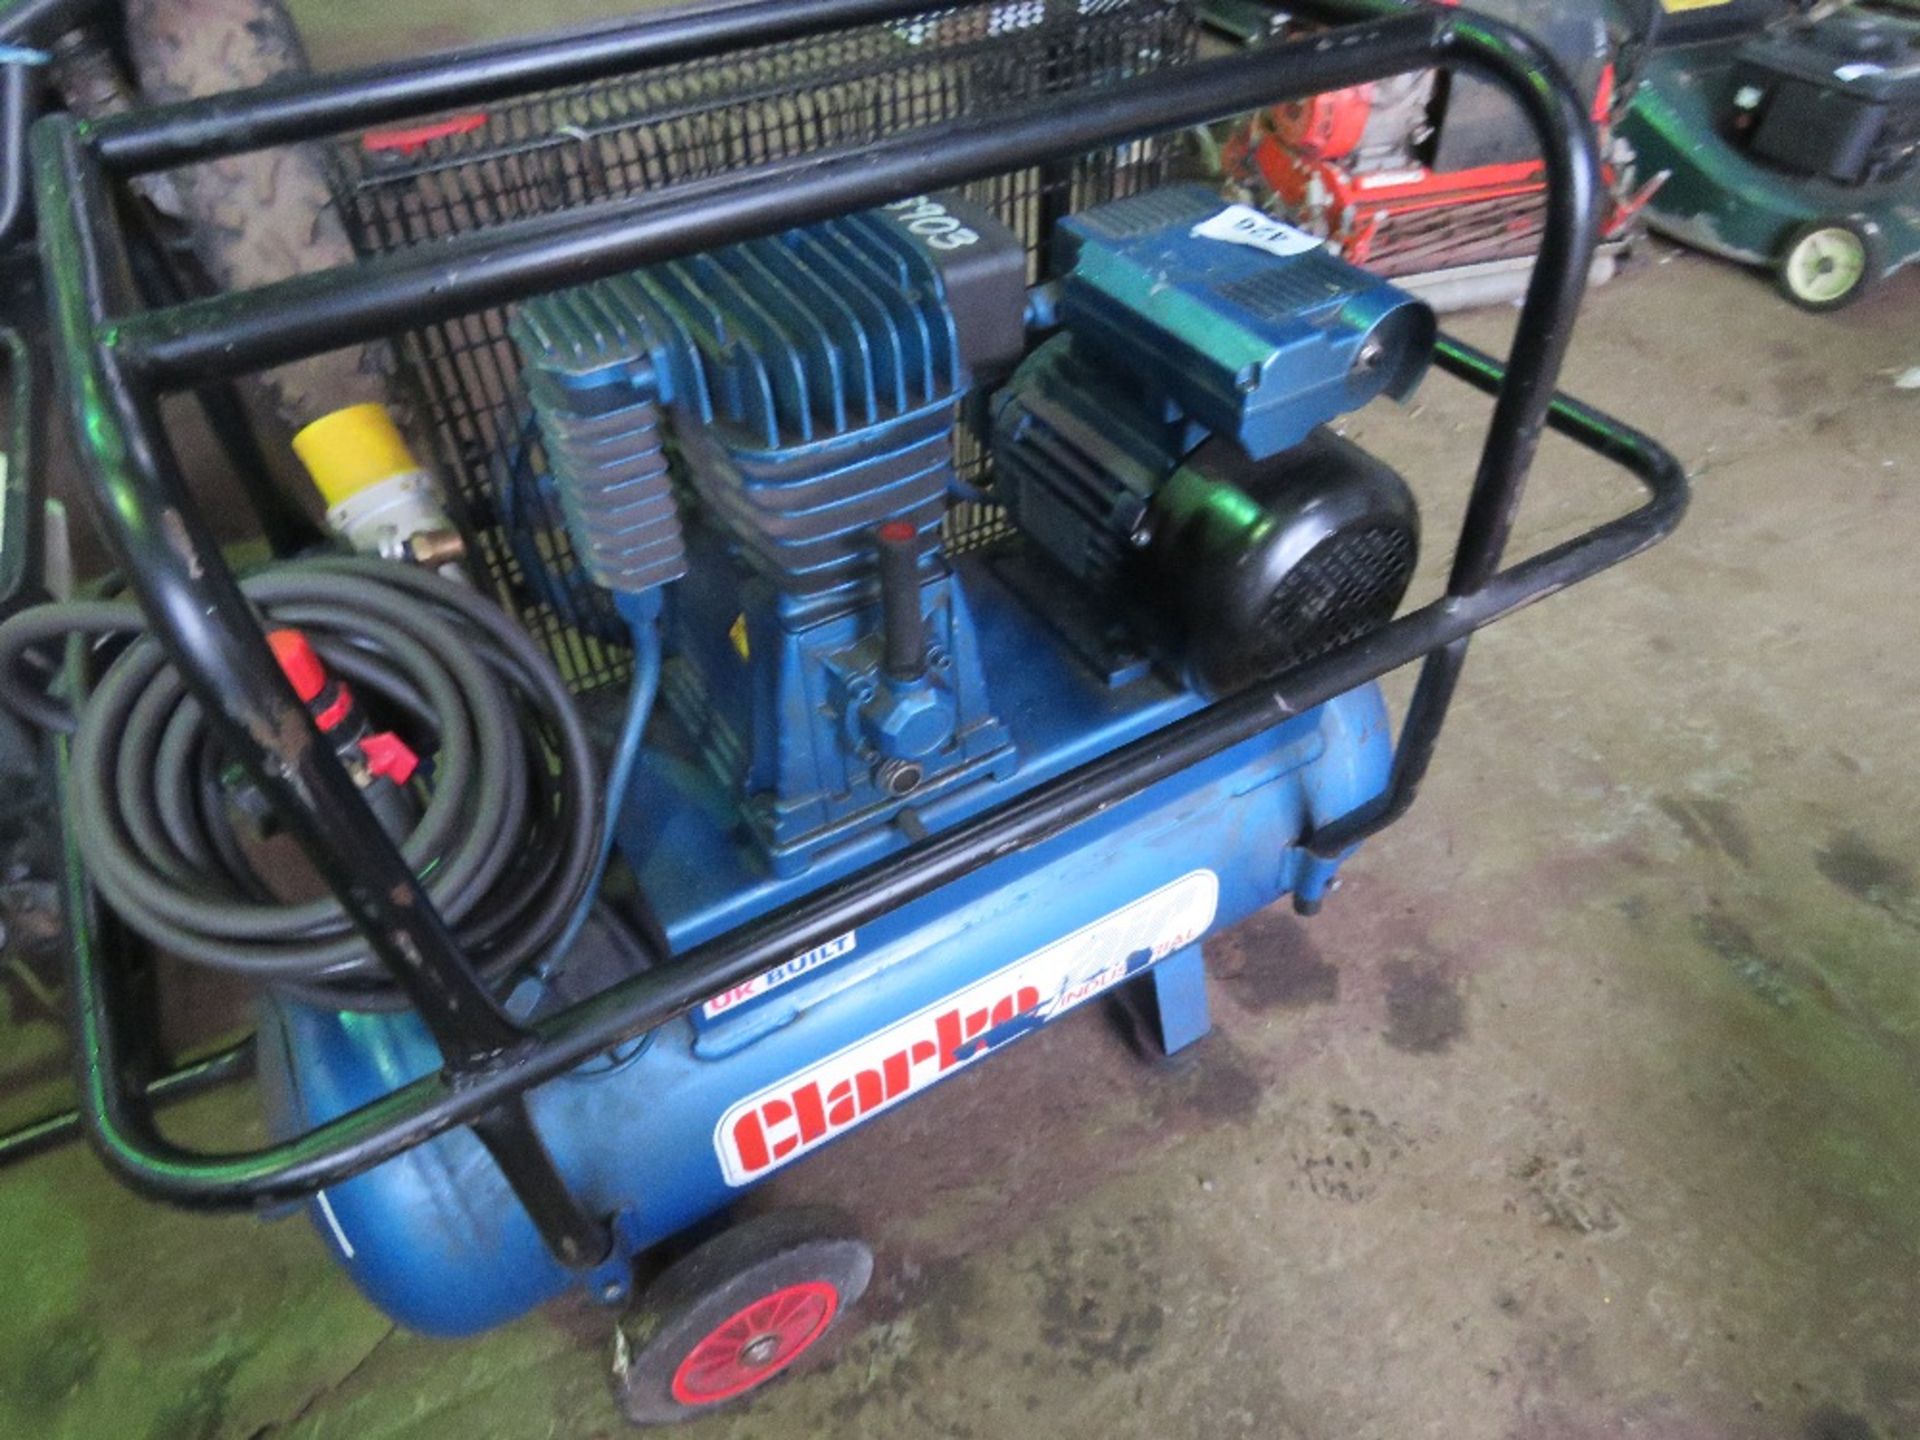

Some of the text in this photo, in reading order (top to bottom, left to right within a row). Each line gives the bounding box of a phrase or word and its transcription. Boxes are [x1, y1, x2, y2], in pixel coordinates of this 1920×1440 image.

[709, 937, 850, 1012] UK BUILT
[1060, 928, 1194, 1009] INDUSRIAL
[733, 986, 1039, 1173] Clarke
